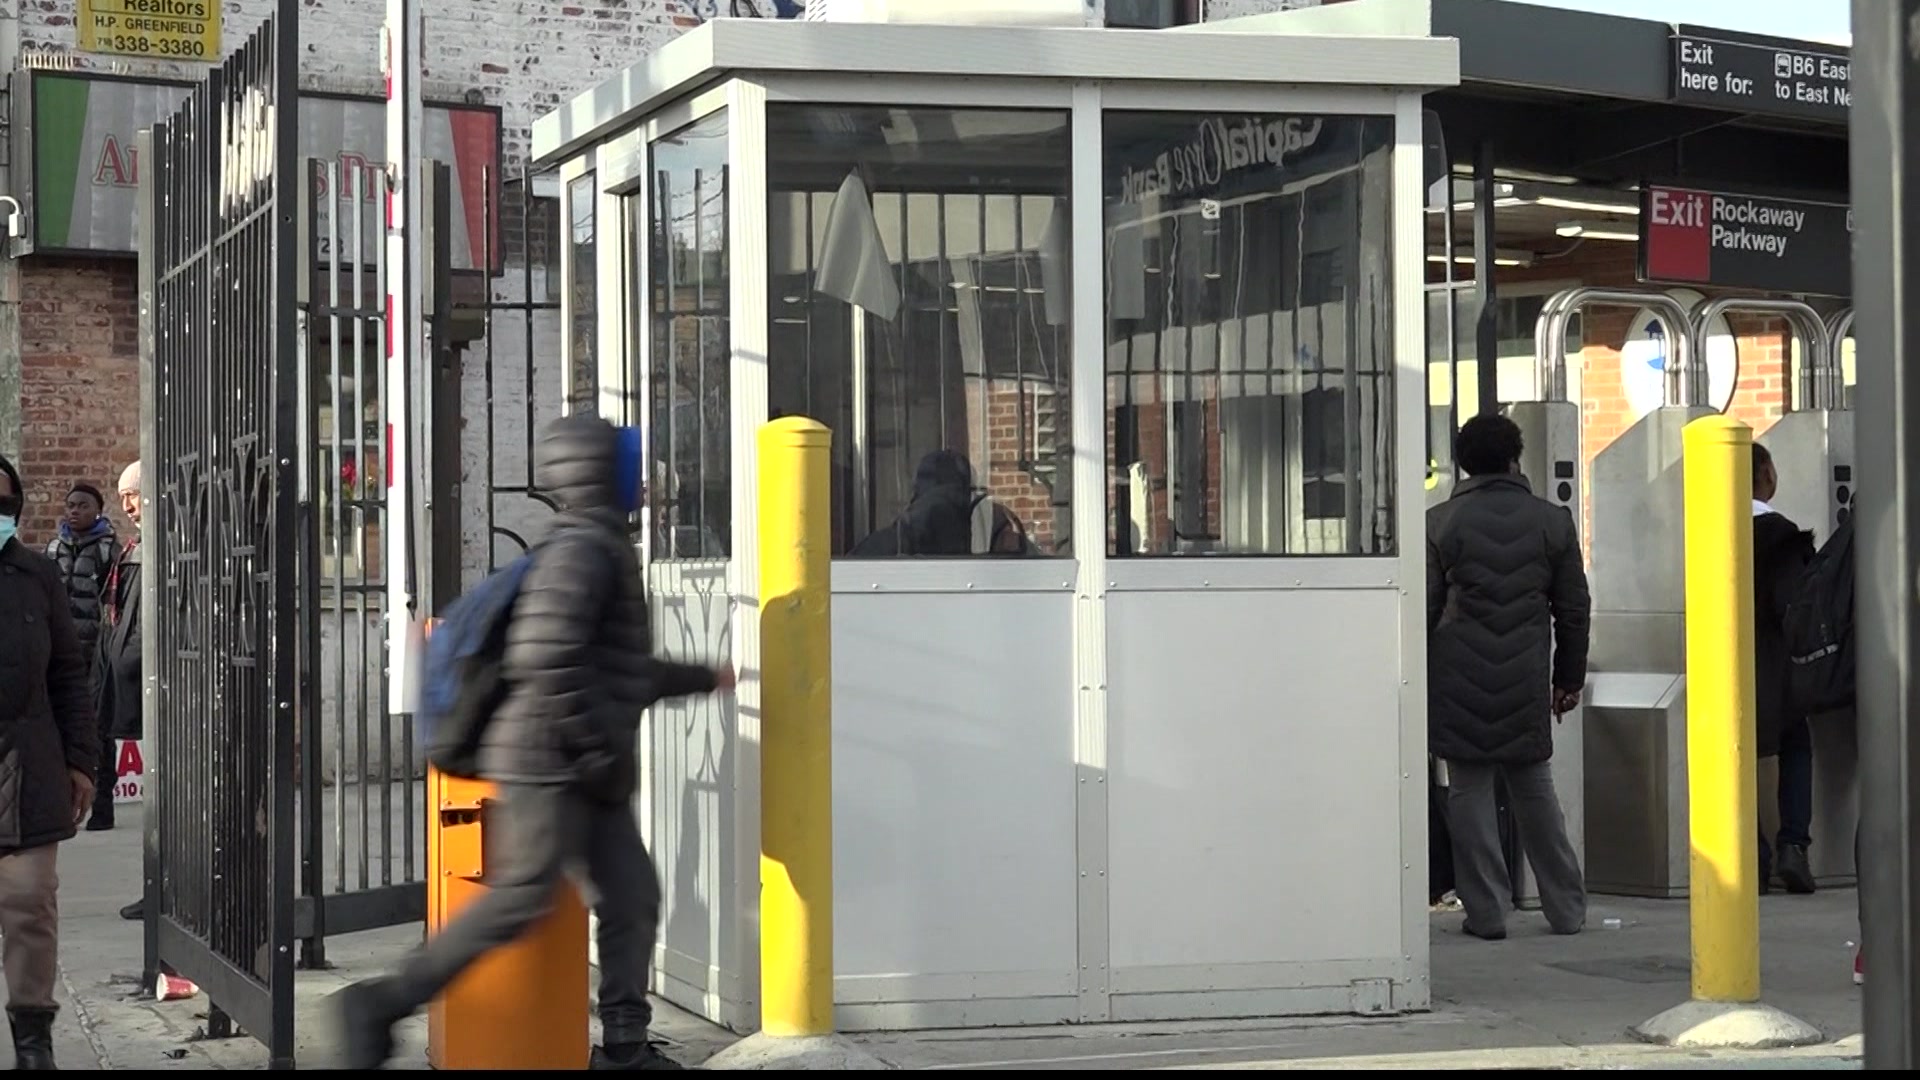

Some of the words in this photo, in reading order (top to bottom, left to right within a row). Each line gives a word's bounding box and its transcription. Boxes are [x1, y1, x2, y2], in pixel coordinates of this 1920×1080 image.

[124, 0, 205, 16] Realtors
[95, 15, 119, 28] H.P.
[125, 18, 205, 34] GREENFIELD
[114, 35, 205, 56] 338-3380
[1681, 41, 1714, 65] Exit
[1793, 55, 1815, 76] B6
[1681, 66, 1718, 92] here
[1725, 72, 1753, 96] for:
[1775, 80, 1790, 99] to
[1796, 82, 1829, 104] East
[1651, 190, 1704, 228] Exit
[1711, 196, 1805, 232] Rockaway
[1711, 224, 1787, 257] Parkway
